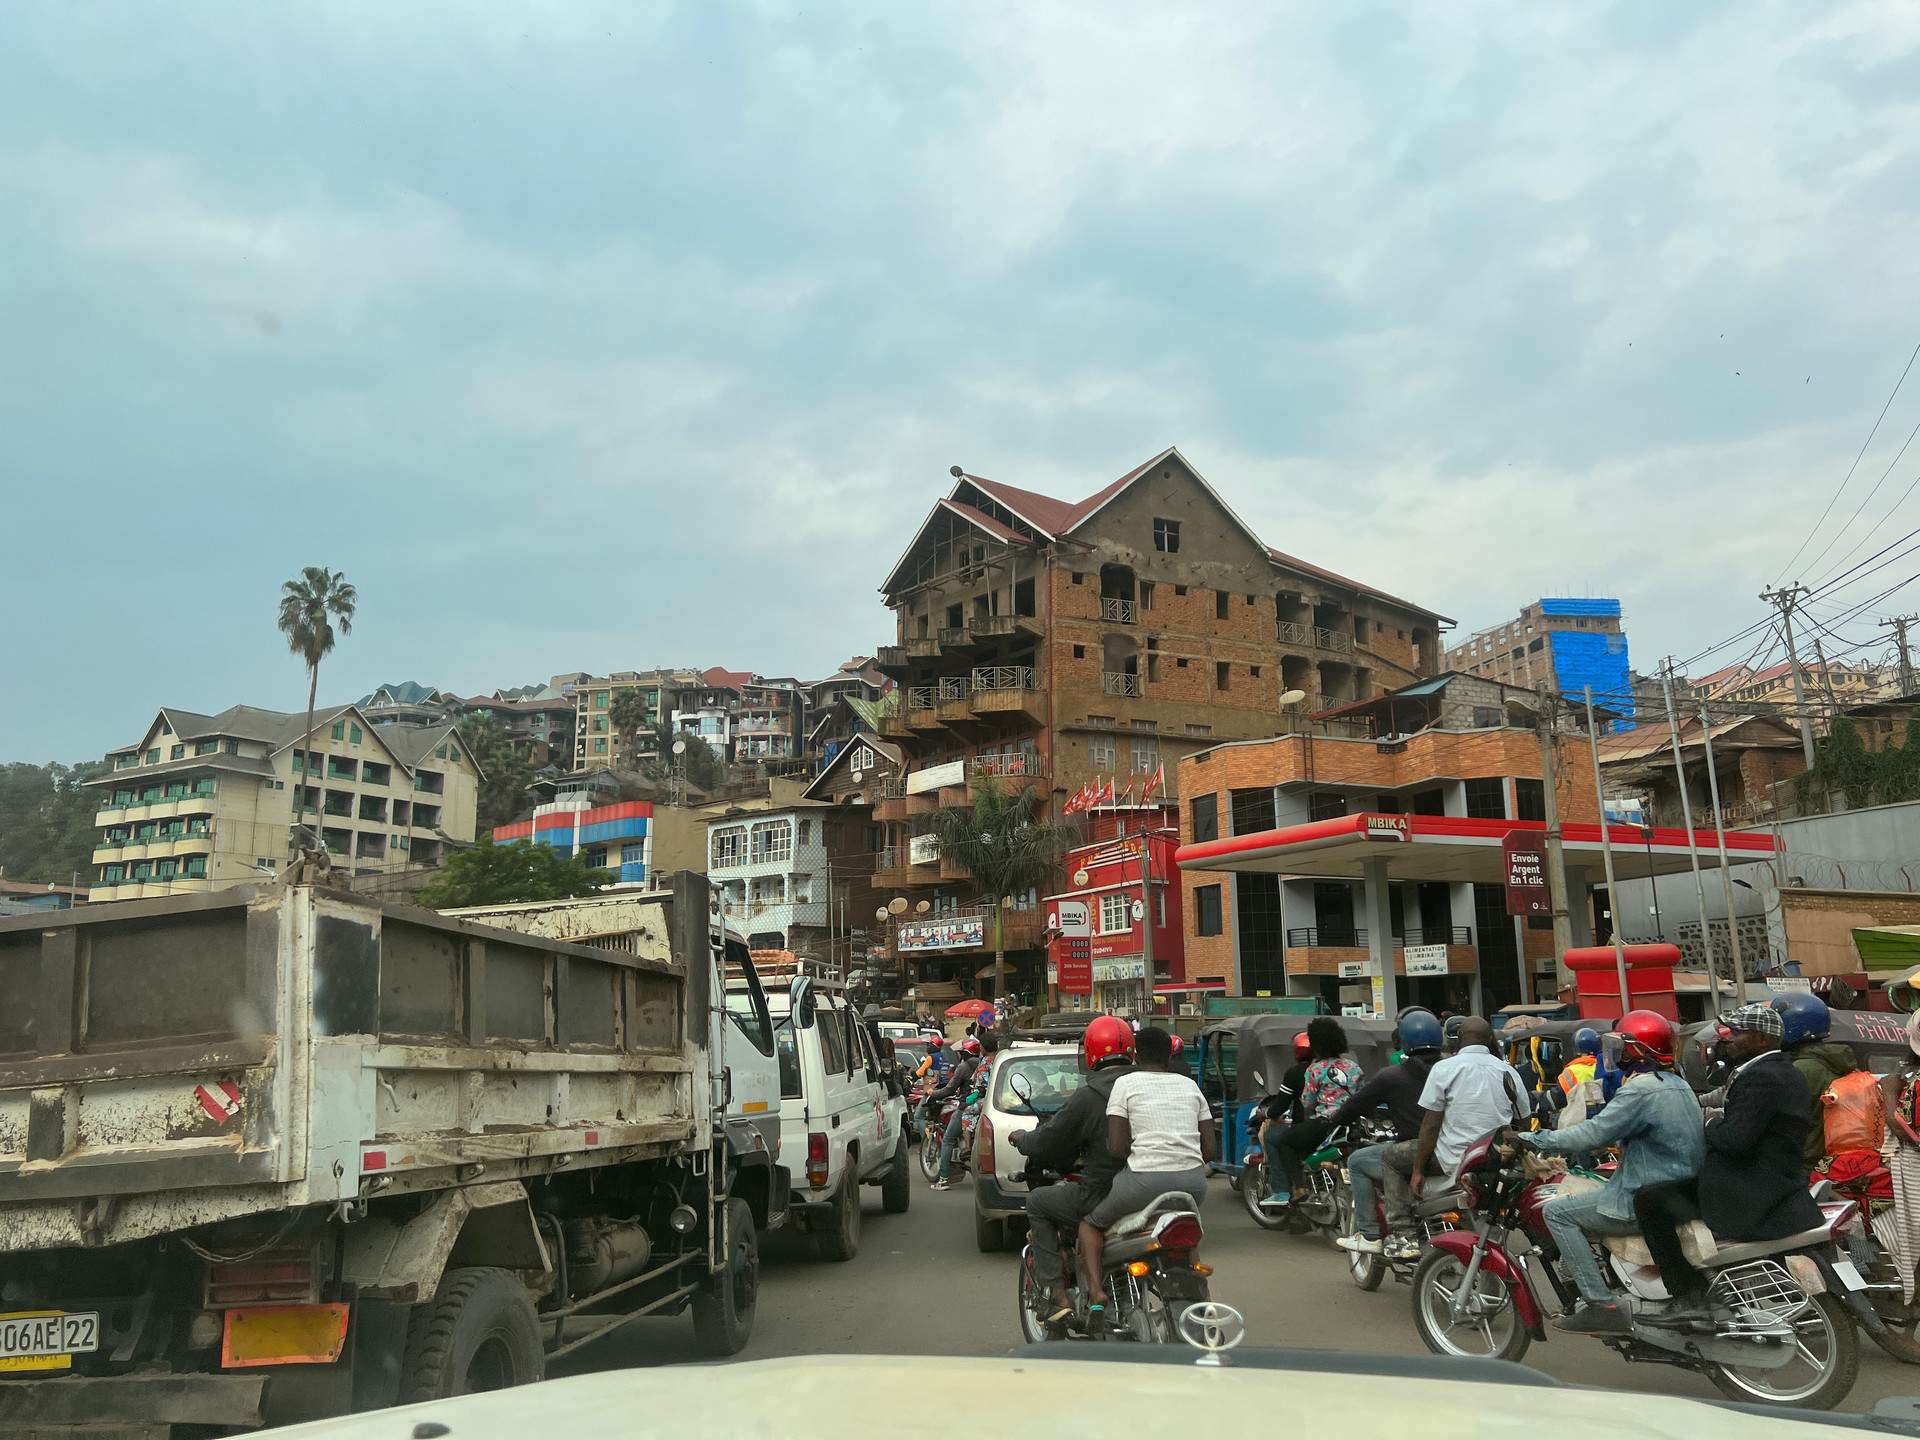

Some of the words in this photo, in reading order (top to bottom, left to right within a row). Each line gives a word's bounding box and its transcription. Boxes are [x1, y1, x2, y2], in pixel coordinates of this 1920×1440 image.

[1367, 816, 1407, 829] MBIKA
[1511, 854, 1539, 863] Envoie
[1512, 865, 1540, 875] Argent
[1510, 875, 1521, 884] En
[1522, 876, 1527, 884] 1
[1529, 875, 1544, 884] clic
[1406, 946, 1445, 954] ALIMENTATION
[1855, 1023, 1909, 1043] PHILIP
[0, 1321, 58, 1352] 06AE
[66, 1318, 95, 1348] 22
